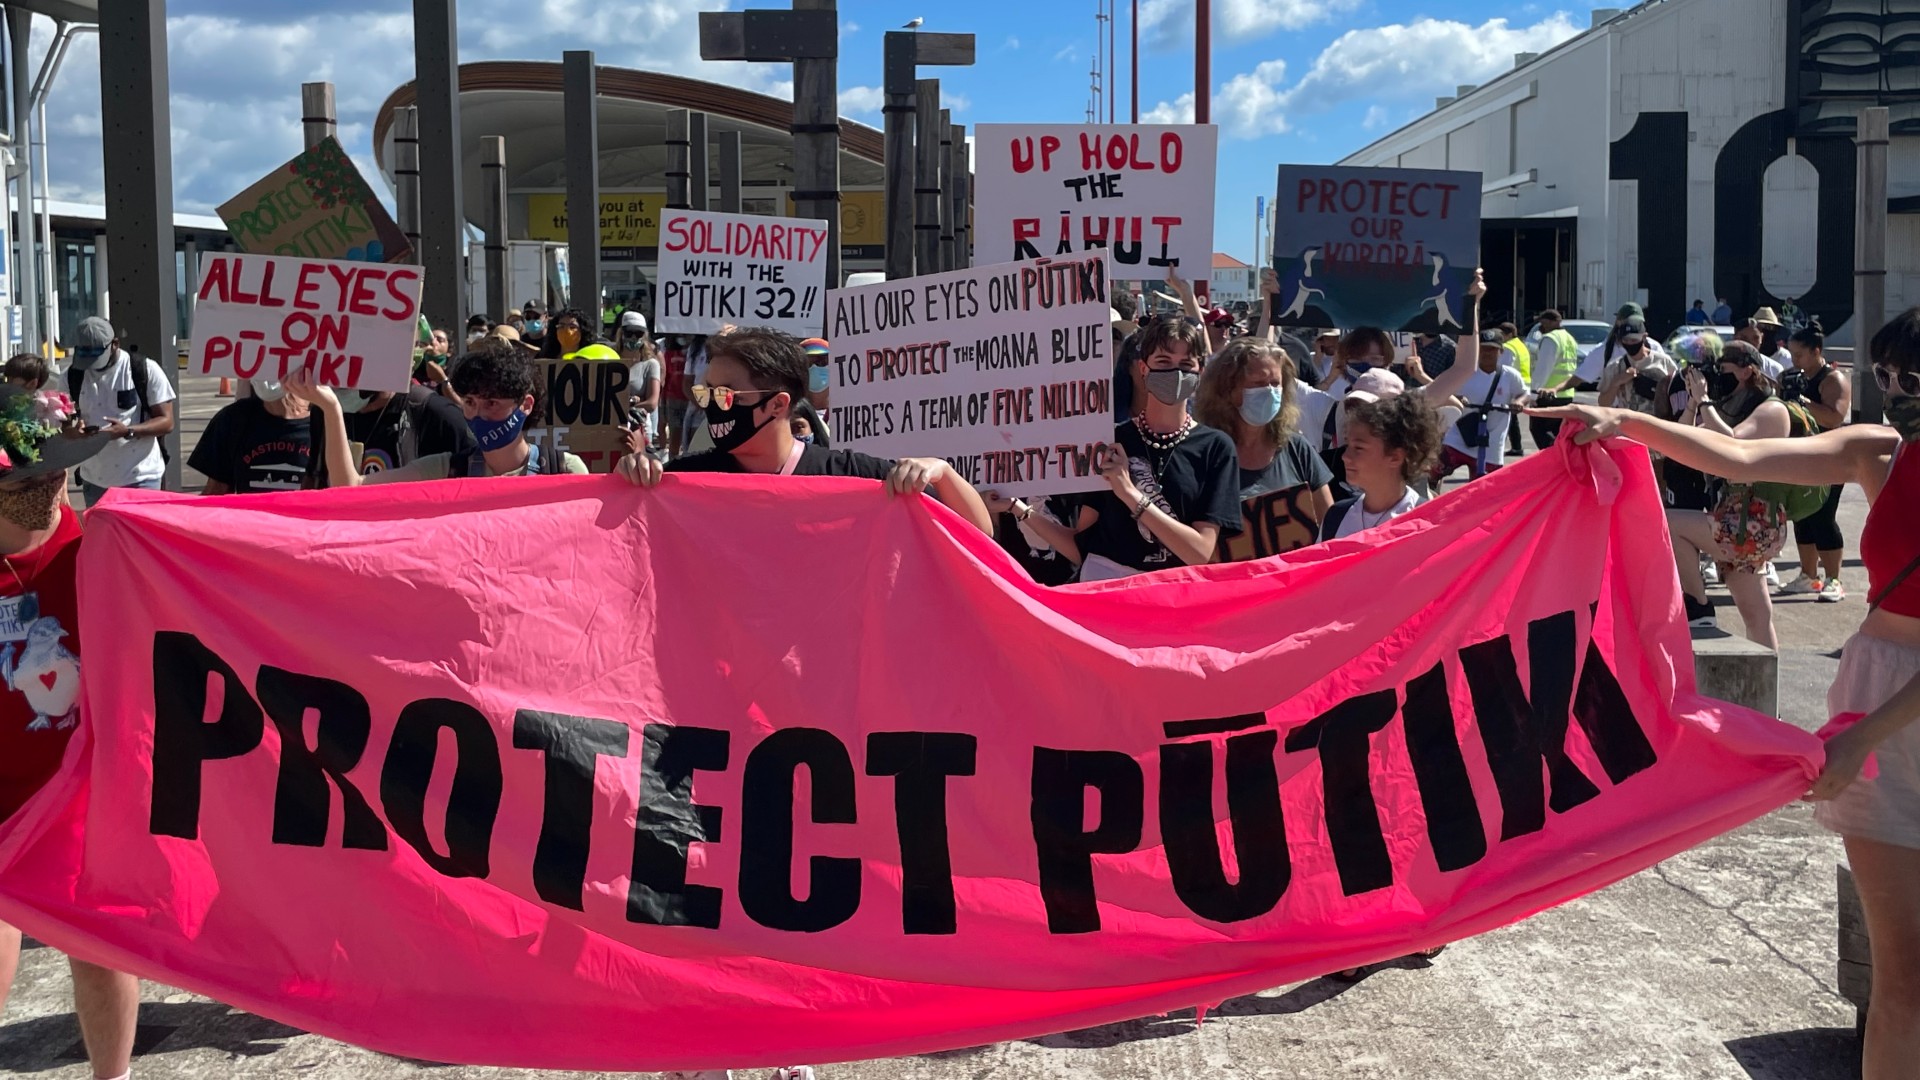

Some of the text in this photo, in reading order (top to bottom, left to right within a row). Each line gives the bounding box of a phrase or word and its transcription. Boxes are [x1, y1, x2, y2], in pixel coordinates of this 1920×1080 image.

[1010, 132, 1183, 174] UP HOLD
[599, 200, 644, 214] you at
[1063, 173, 1123, 202] THE
[1297, 178, 1460, 220] PROTECT
[553, 215, 656, 228] th art line.
[665, 217, 827, 263] SOLIDARITY
[1013, 210, 1182, 267] RĀHUI
[1350, 216, 1404, 241] OUR
[1609, 108, 1857, 338] 10
[199, 258, 418, 321] ALL EYES
[684, 260, 784, 283] WITH THE
[664, 280, 745, 318] PŪTIKI
[834, 257, 1105, 338] ALL OUR EYES ON PŪTIKI
[281, 311, 350, 351] ON
[203, 330, 363, 388] PŪTIKI
[834, 323, 1104, 387] TO PROTECT THE MOANA BLUE
[832, 379, 1110, 443] THERE'S A TEAM OF FIVE MILLION
[983, 441, 1108, 484] THIRTY-TWO
[149, 600, 1658, 936] PROTECT PŪTIKI
